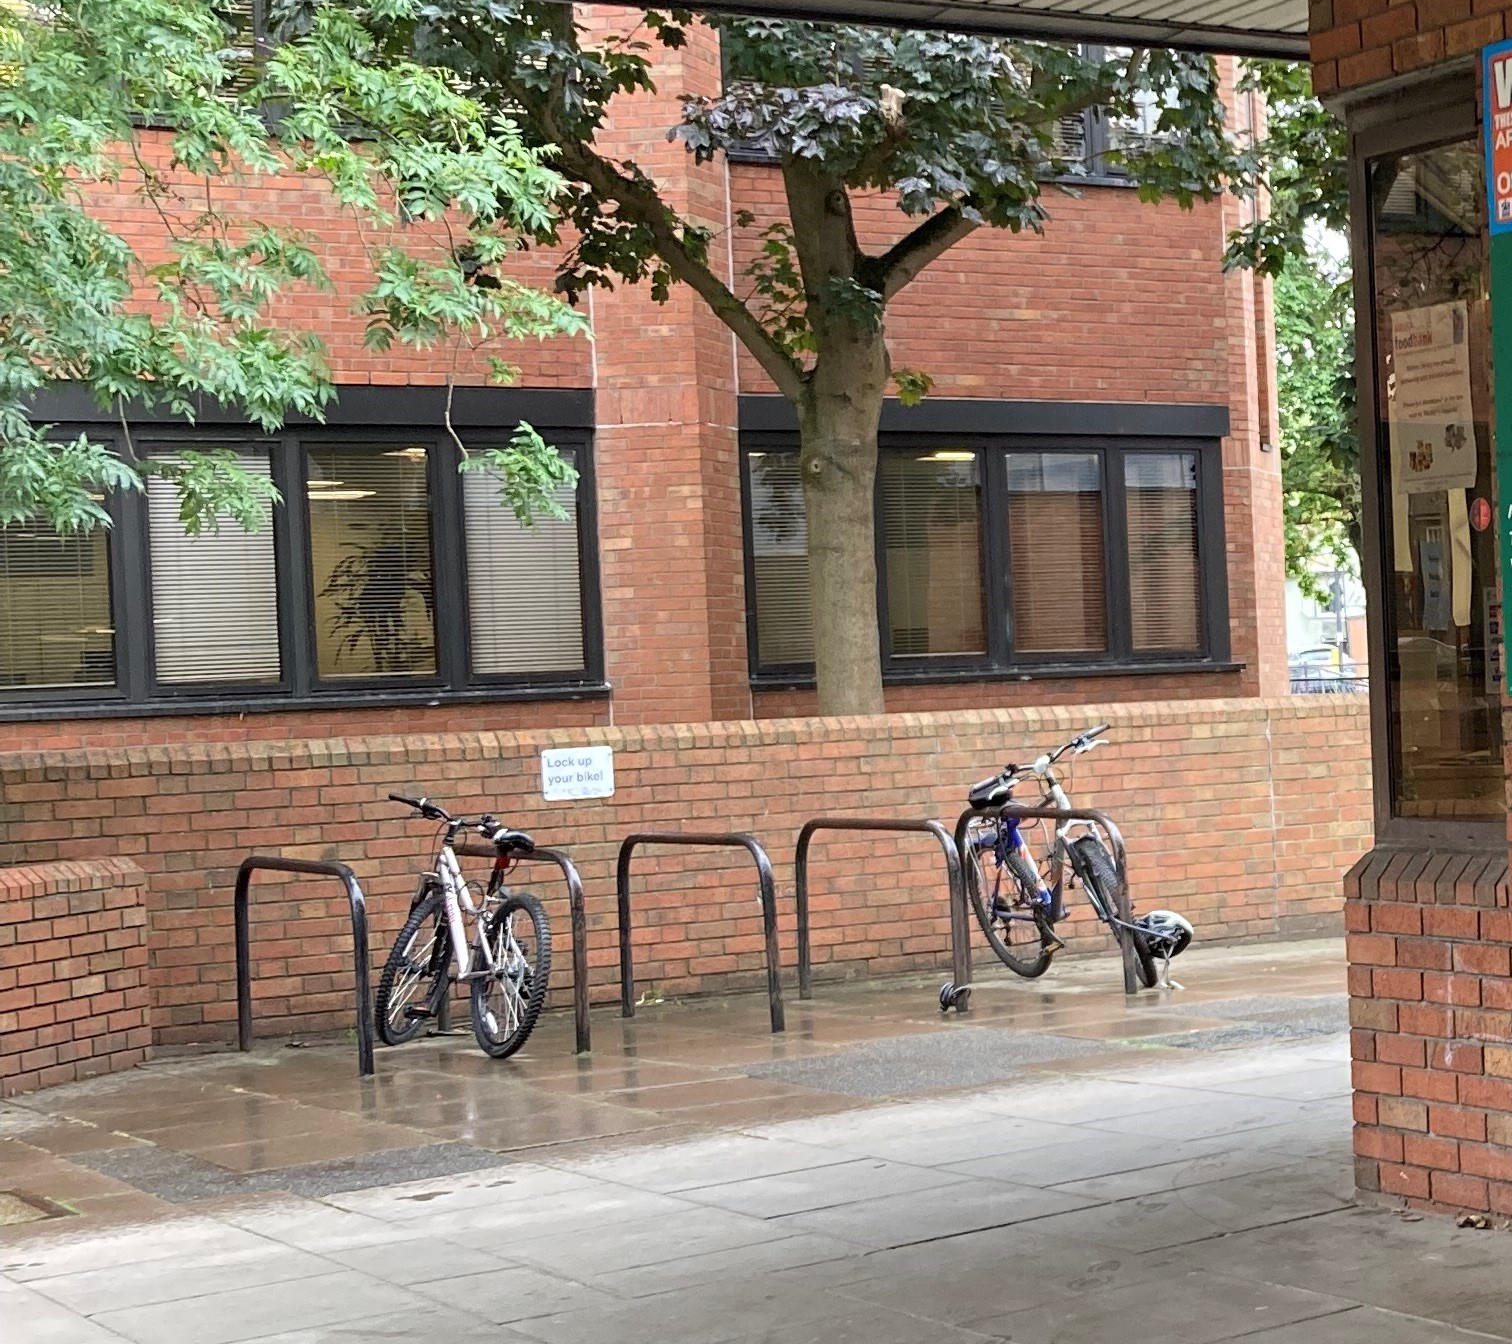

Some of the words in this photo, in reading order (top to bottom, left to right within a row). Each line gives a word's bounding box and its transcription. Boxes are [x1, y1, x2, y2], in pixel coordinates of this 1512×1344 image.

[547, 757, 575, 768] Lock
[578, 757, 592, 767] up
[548, 775, 573, 786] your
[576, 771, 604, 782] bike!
